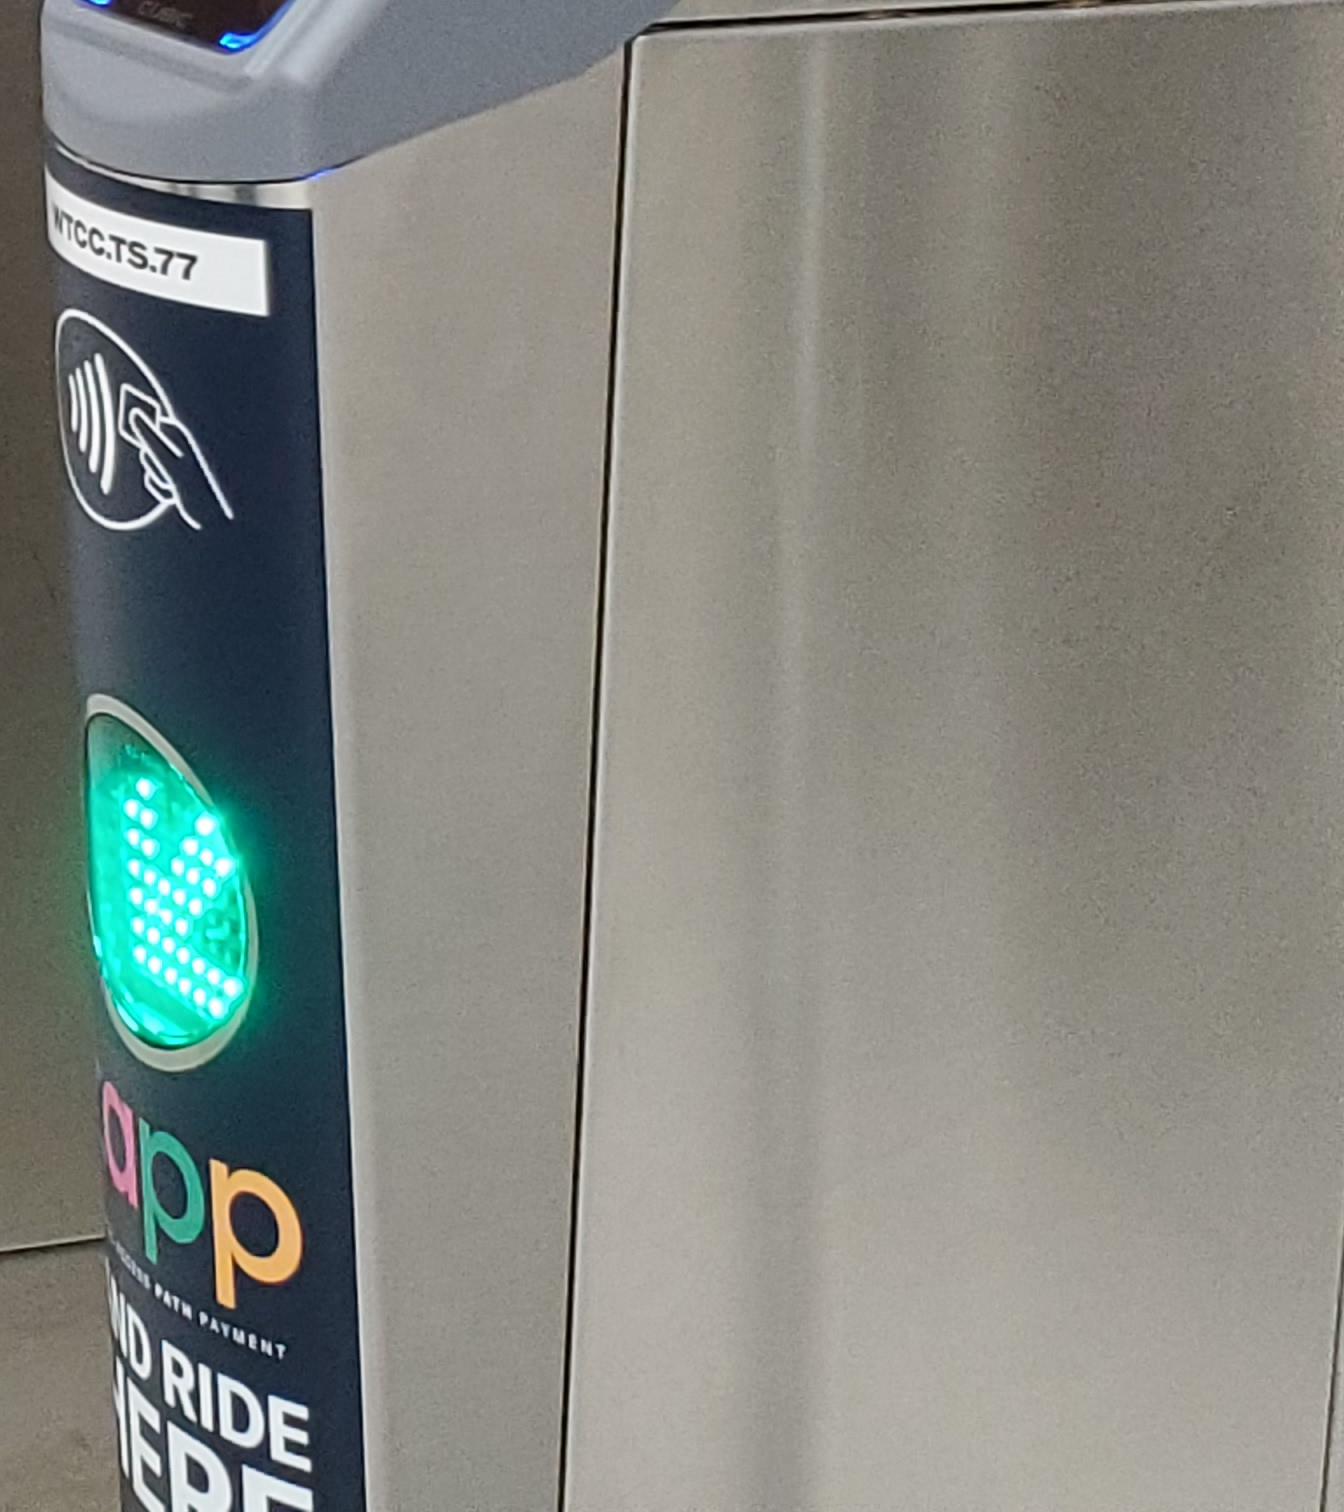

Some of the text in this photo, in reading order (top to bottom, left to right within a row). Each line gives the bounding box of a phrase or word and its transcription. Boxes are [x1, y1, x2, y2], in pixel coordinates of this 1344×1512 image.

[102, 1081, 303, 1310] app
[106, 1256, 313, 1472] ND RIDE
[155, 1282, 287, 1360] PATH PAYMENT
